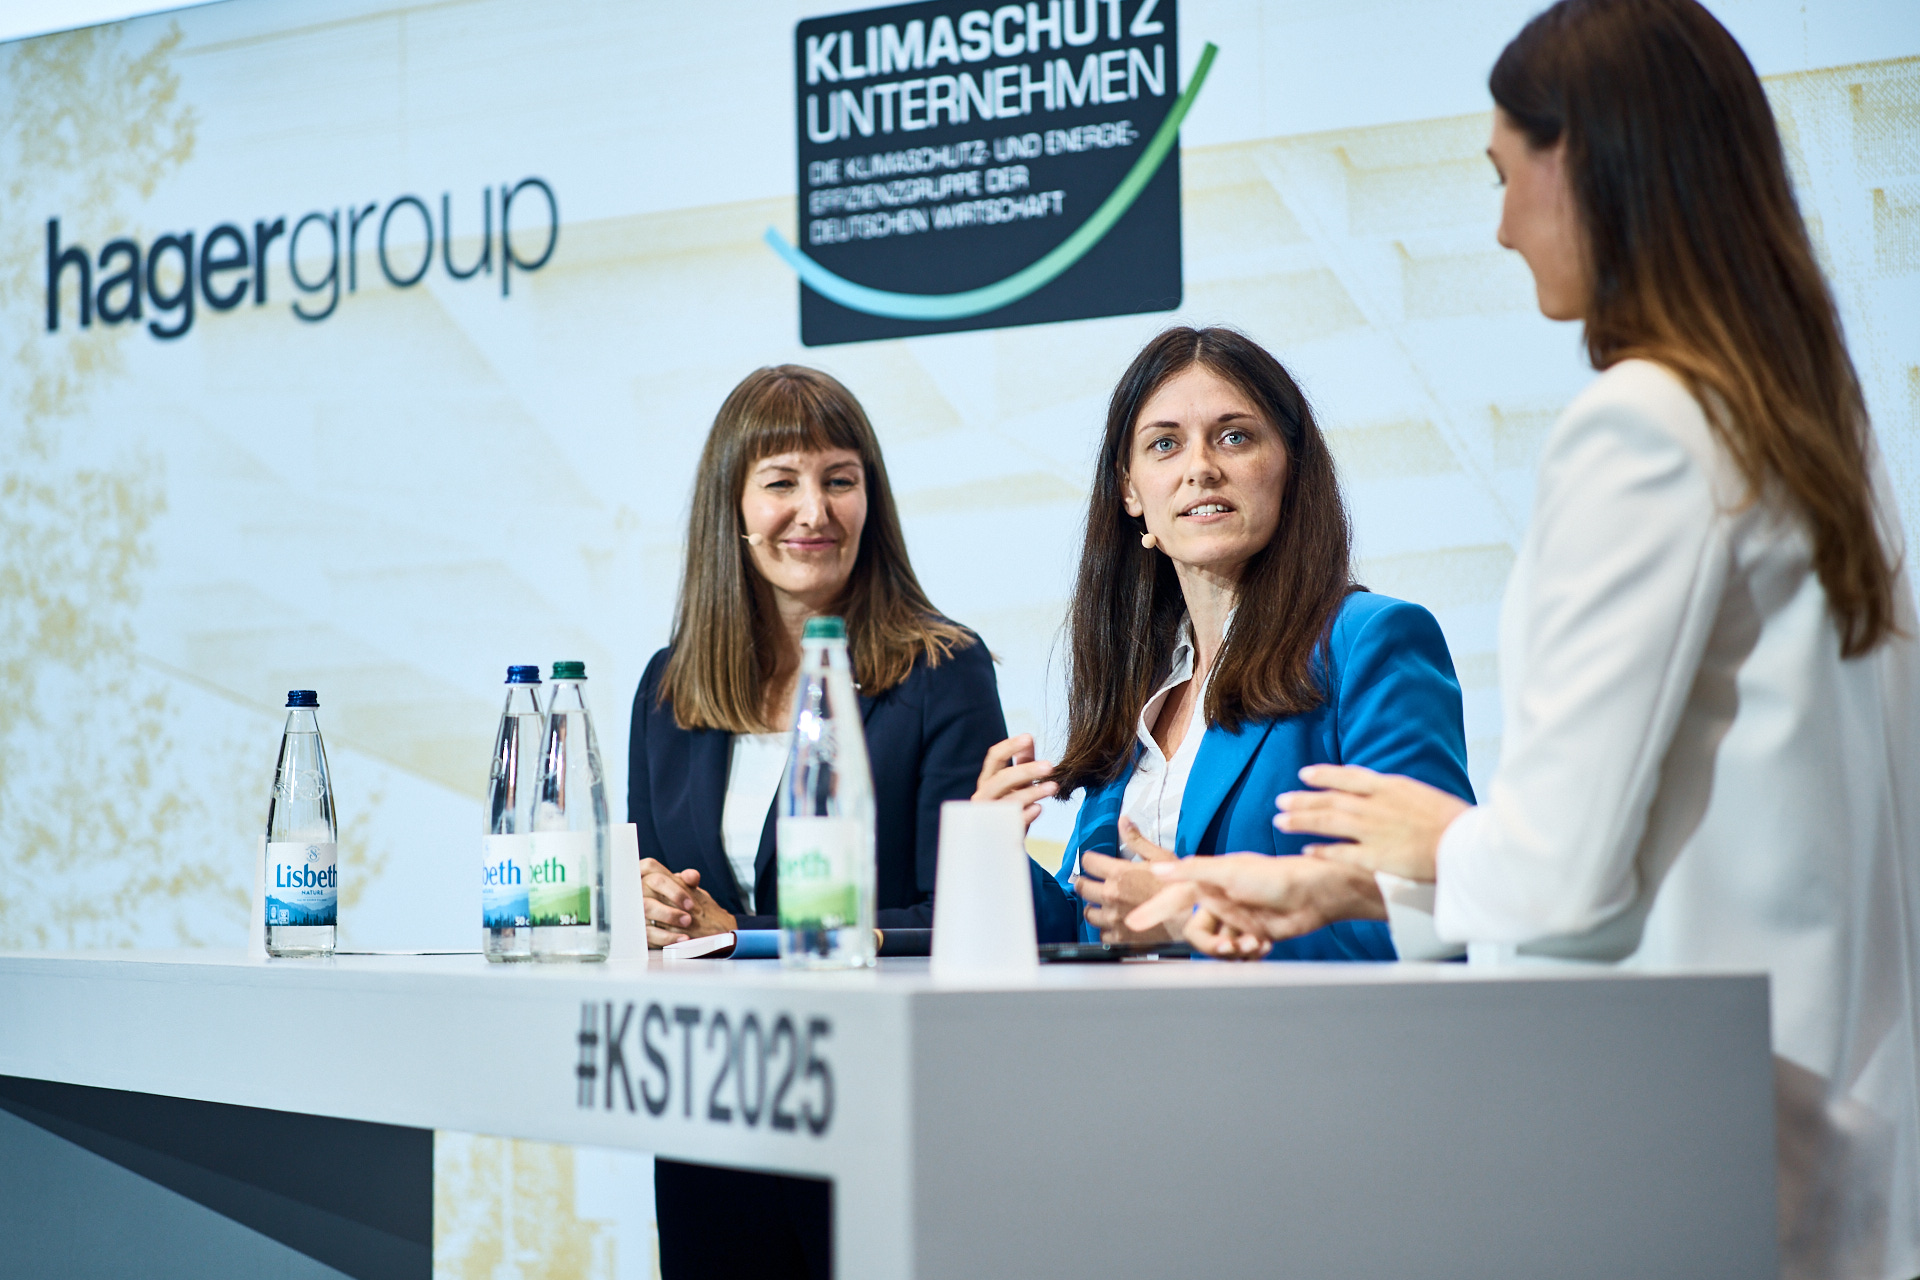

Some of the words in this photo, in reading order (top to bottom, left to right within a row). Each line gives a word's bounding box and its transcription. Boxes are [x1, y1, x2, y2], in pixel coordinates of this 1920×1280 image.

[805, 0, 1165, 85] KLIMASCHUTZ
[806, 44, 1166, 143] UNTERNEHMEN
[808, 158, 843, 187] DIE
[993, 132, 1043, 163] UND
[984, 164, 1031, 194] DER
[809, 208, 929, 246] DEUTSCHEN
[930, 190, 1067, 232] WIRTSCHAFT
[276, 863, 337, 888] Lisbeth
[576, 1000, 836, 1139] #KST2025
